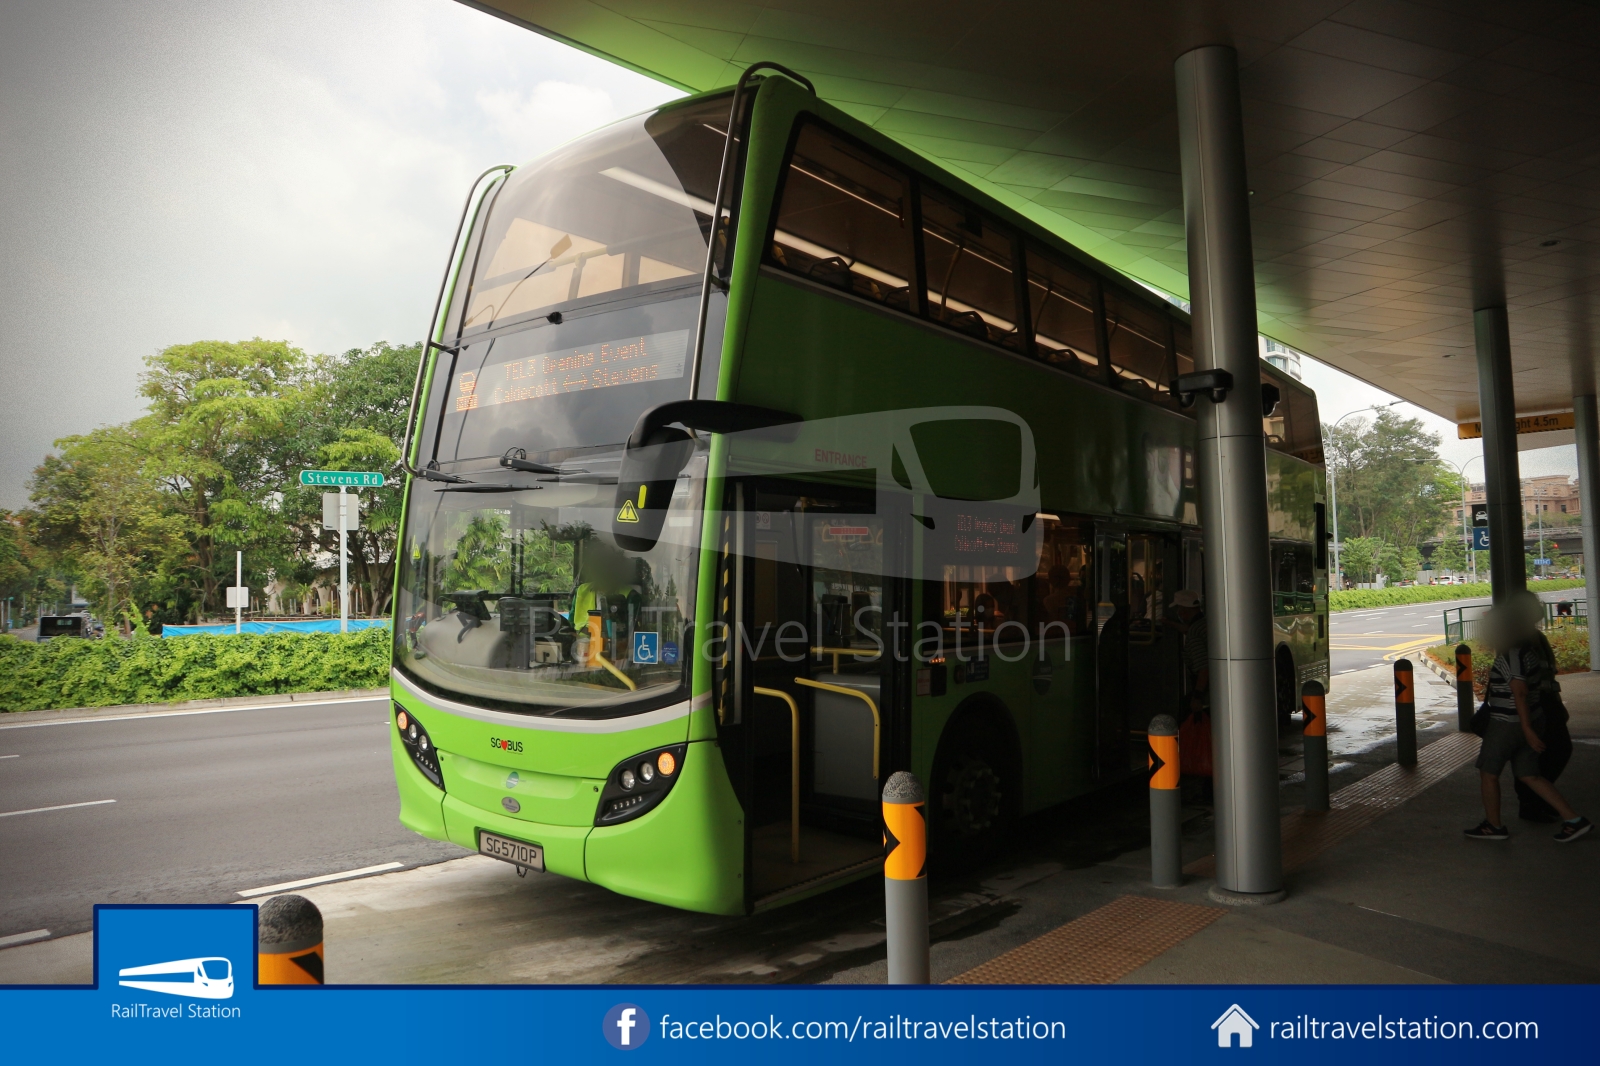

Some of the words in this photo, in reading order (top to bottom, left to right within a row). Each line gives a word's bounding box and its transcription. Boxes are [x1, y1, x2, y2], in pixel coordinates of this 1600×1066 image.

[504, 358, 537, 381] TEL3
[542, 350, 596, 375] Opening
[601, 337, 647, 364] Event
[493, 377, 559, 405] Caldecott
[592, 363, 659, 389] Stevens
[1534, 416, 1559, 428] 4.5m
[814, 448, 868, 469] ENTRANCE
[307, 472, 359, 485] Stevens
[363, 474, 378, 485] Rd
[486, 836, 537, 864] SG5710P
